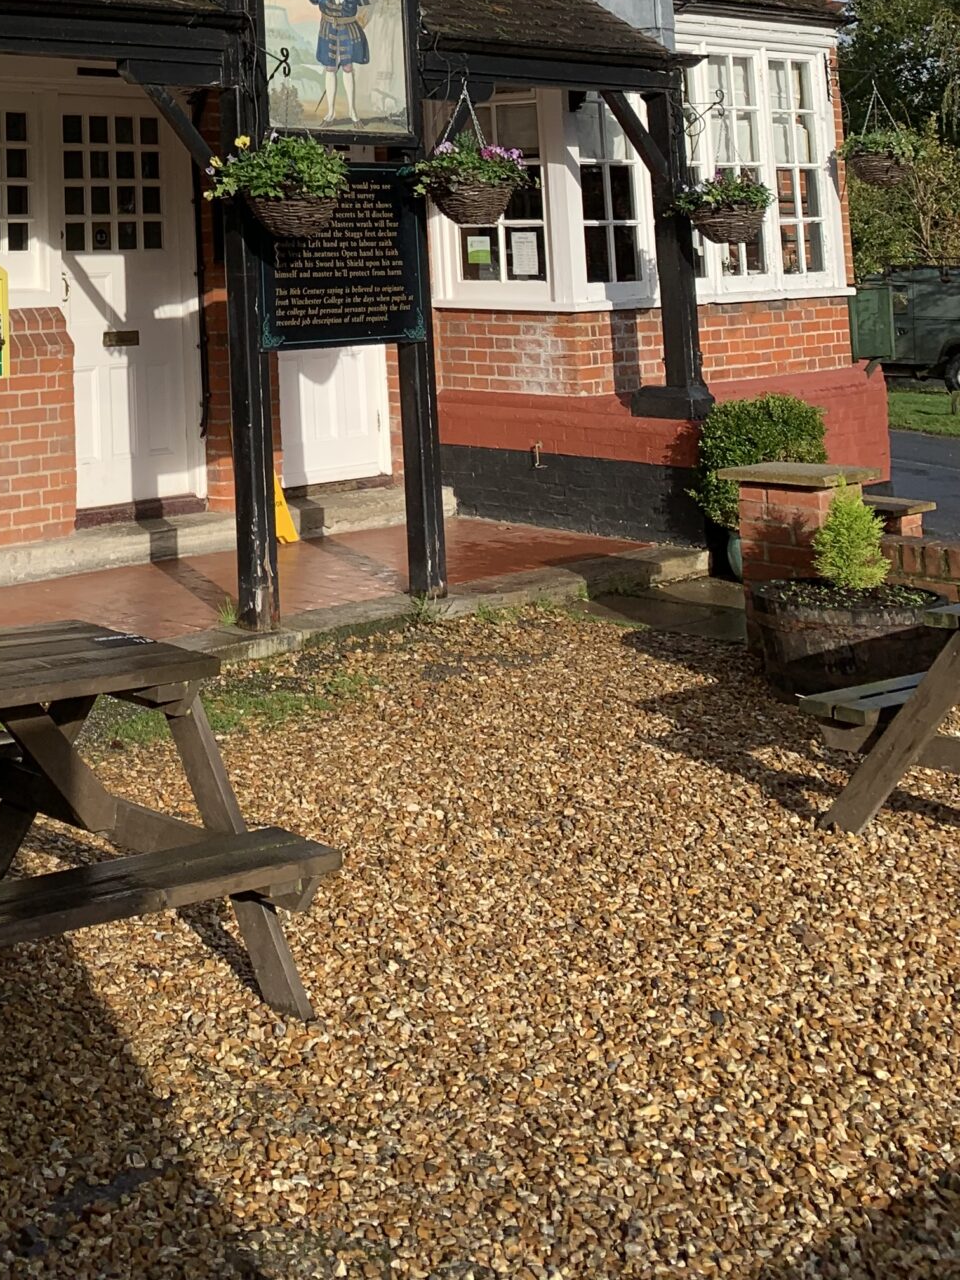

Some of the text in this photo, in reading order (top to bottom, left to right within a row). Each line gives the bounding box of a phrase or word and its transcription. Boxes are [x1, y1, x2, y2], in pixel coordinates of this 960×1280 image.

[352, 181, 368, 190] would
[370, 183, 380, 192] you
[363, 200, 374, 208] diet
[376, 200, 392, 208] shows
[357, 210, 370, 218] he'll
[371, 210, 393, 218] disclose
[331, 219, 399, 227] Masters wrath will bear
[333, 229, 343, 237] the
[344, 229, 363, 239] Staggs
[377, 229, 398, 237] declare
[308, 239, 321, 247] Left
[323, 239, 337, 247] hand
[339, 241, 348, 249] apt
[359, 238, 376, 246] labour
[378, 238, 392, 246] saith
[303, 249, 311, 257] his
[341, 249, 357, 258] Open
[359, 248, 373, 256] hand
[375, 248, 384, 256] his
[385, 247, 398, 256] faith
[290, 259, 303, 268] with
[305, 259, 314, 268] his
[316, 258, 334, 267] Sword
[336, 259, 345, 267] his
[346, 258, 364, 267] Shield
[366, 260, 381, 268] upon
[274, 269, 297, 278] himself
[299, 269, 311, 277] and
[334, 269, 348, 277] he'll
[349, 269, 370, 278] protect
[372, 268, 386, 276] from
[387, 268, 402, 276] harm
[275, 287, 288, 296] This
[302, 286, 326, 296] Century
[327, 286, 343, 295] saying
[352, 284, 374, 293] believed
[382, 284, 405, 293] originate
[275, 297, 289, 306] from
[291, 295, 322, 305] Winchester
[323, 294, 344, 305] College
[352, 294, 362, 303] the
[363, 293, 375, 303] days
[376, 293, 390, 301] when
[391, 292, 407, 302] pupils
[276, 301, 411, 317] the college had personal servants possibly the first
[275, 317, 301, 327] recorded
[301, 317, 311, 327] job
[312, 315, 343, 325] description
[344, 314, 350, 323] of
[351, 314, 364, 323] staff
